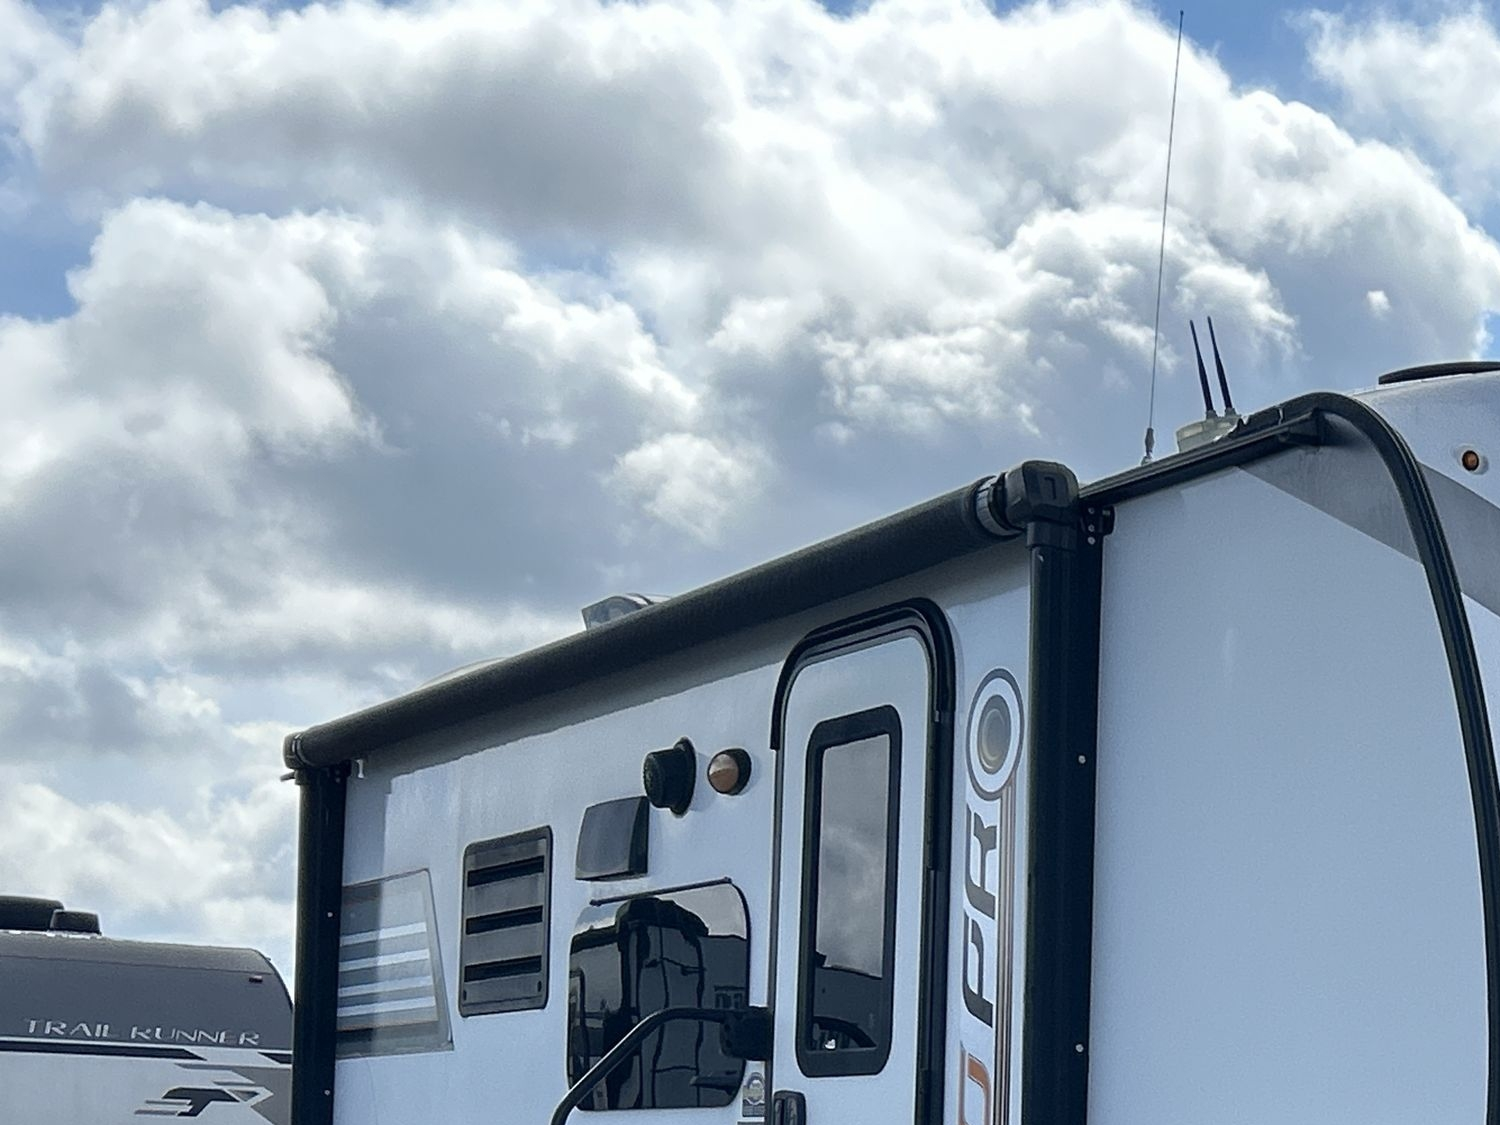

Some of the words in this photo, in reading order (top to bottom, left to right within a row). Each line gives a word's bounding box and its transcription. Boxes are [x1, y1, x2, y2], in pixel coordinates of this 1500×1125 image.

[961, 667, 1025, 1029] PRO
[26, 1018, 118, 1038] TRAIL
[130, 1026, 261, 1046] RUNNER
